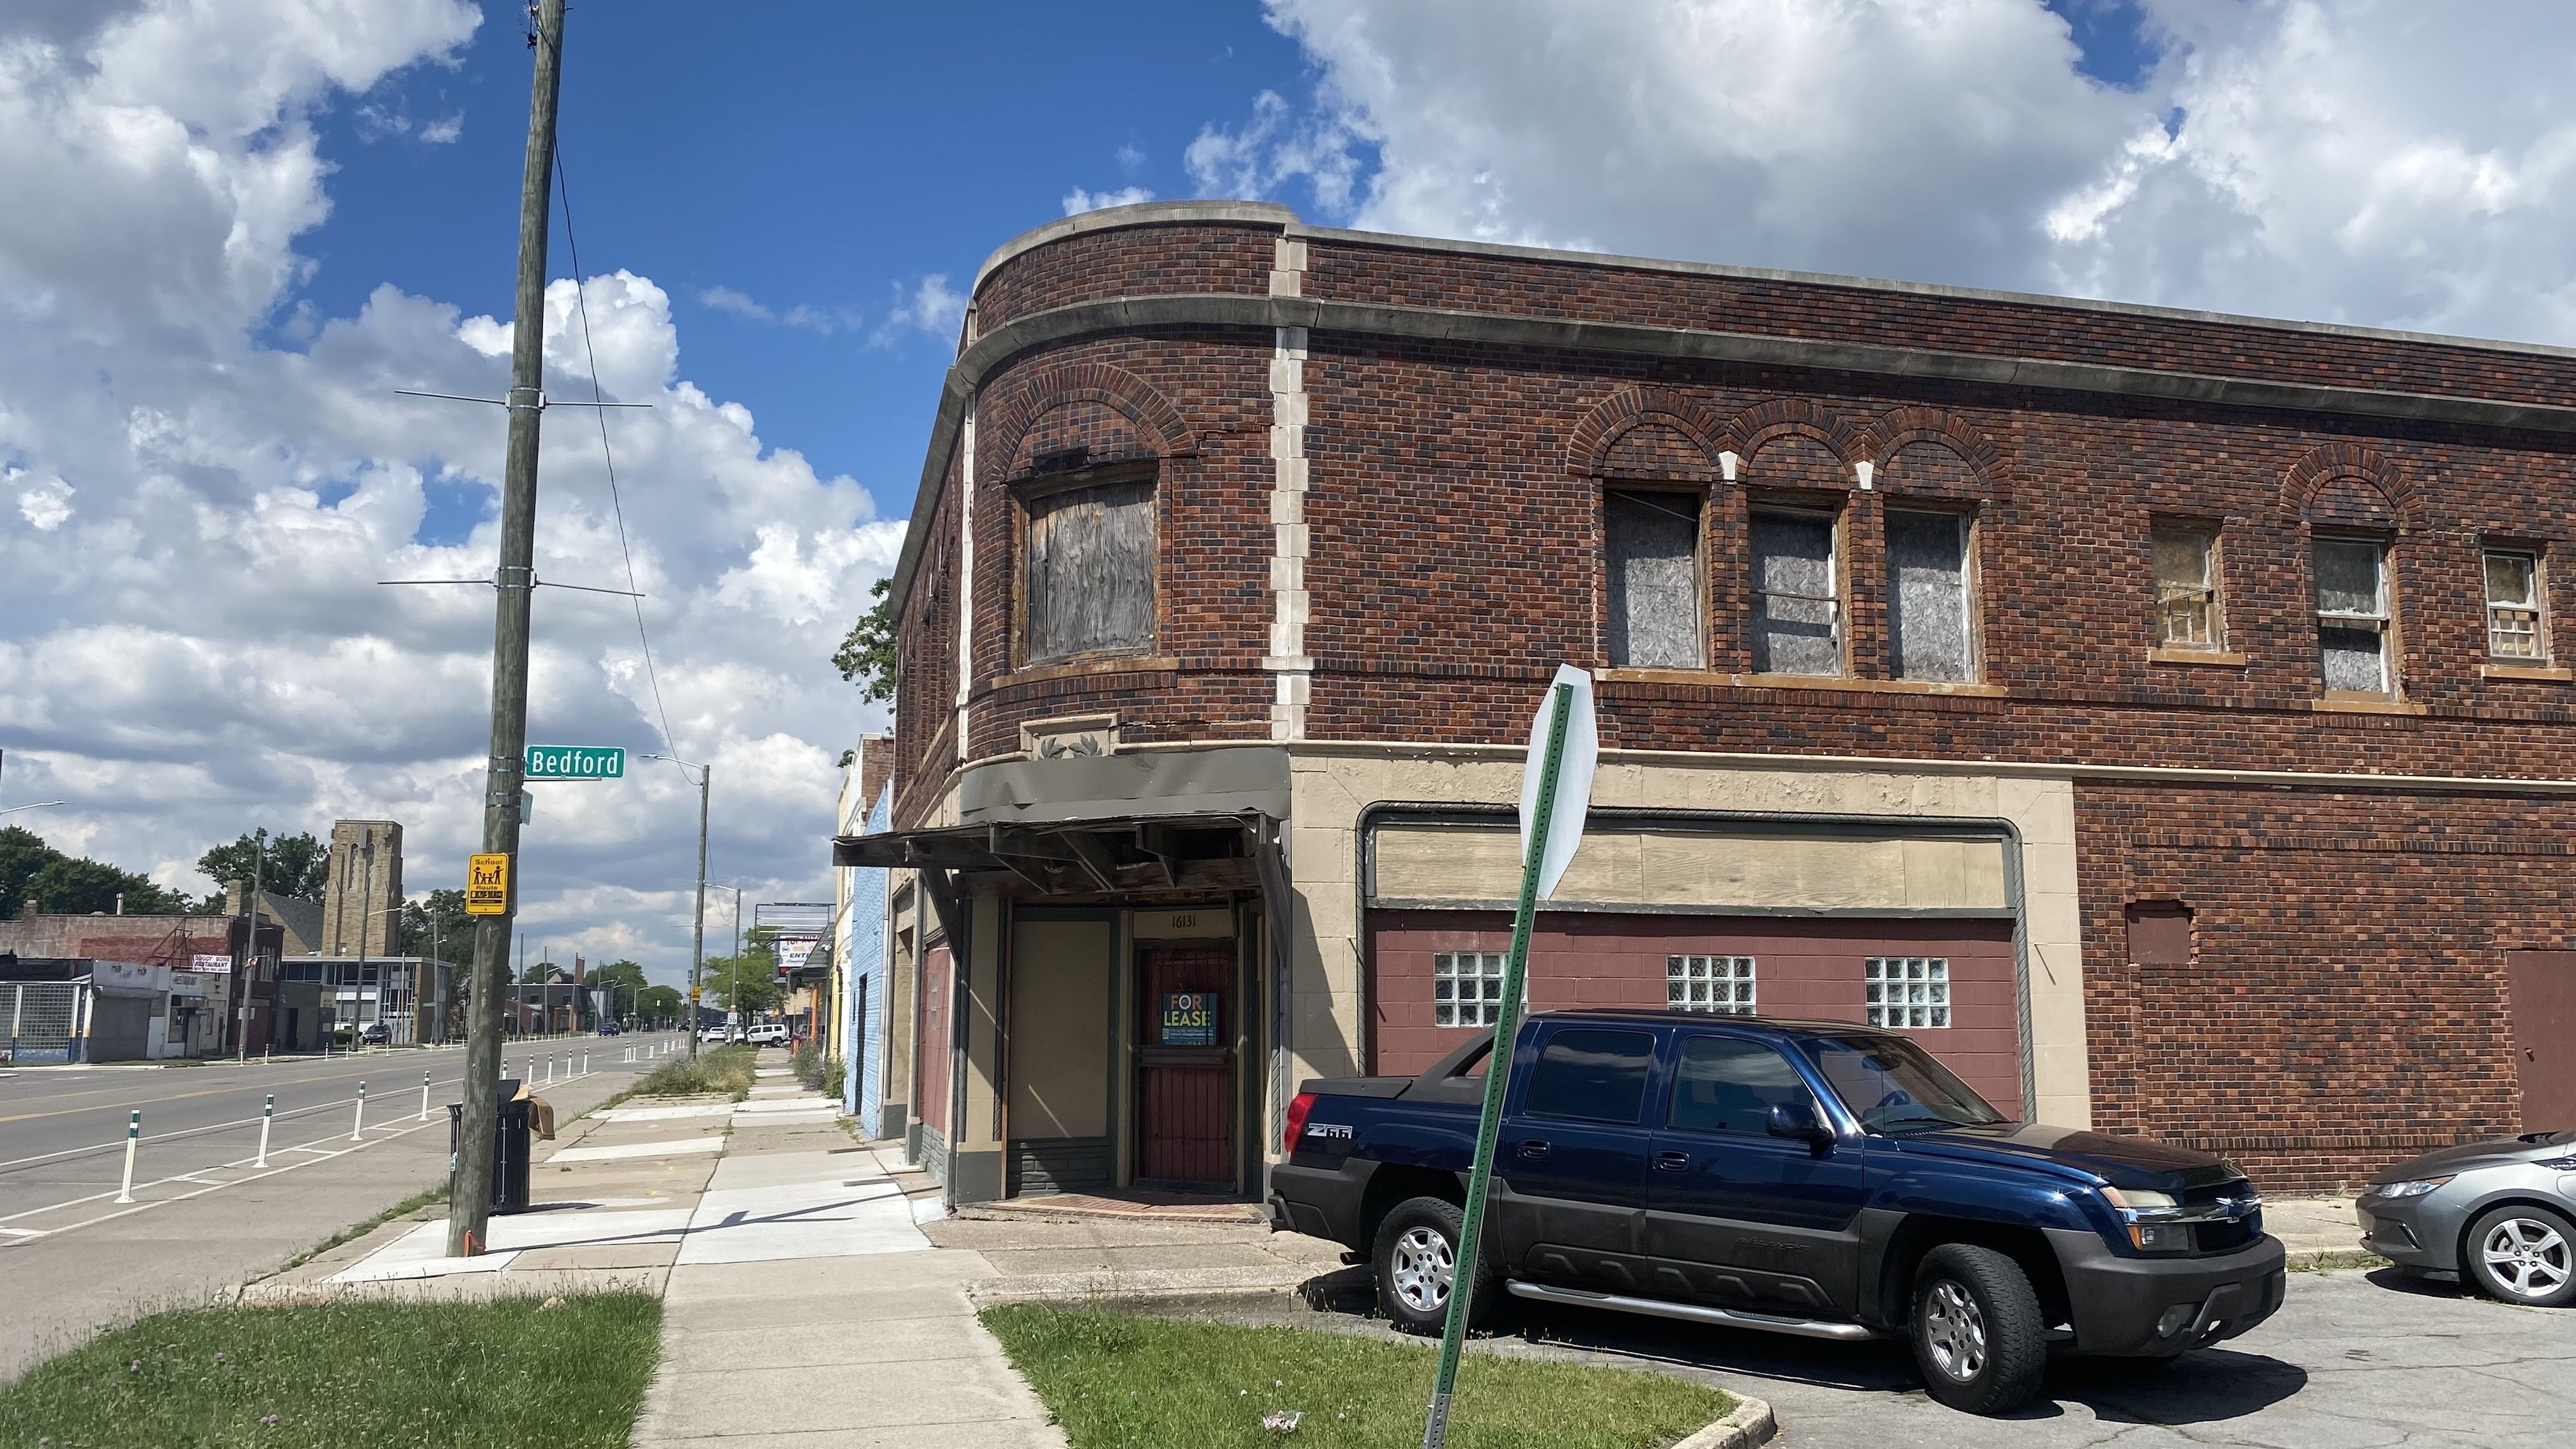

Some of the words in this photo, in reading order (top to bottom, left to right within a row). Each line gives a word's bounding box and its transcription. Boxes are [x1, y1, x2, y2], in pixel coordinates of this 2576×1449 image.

[532, 751, 618, 774] Bedford
[1172, 914, 1196, 928] 16131
[1171, 995, 1202, 1010] FOR
[1164, 1011, 1211, 1027] LEASE
